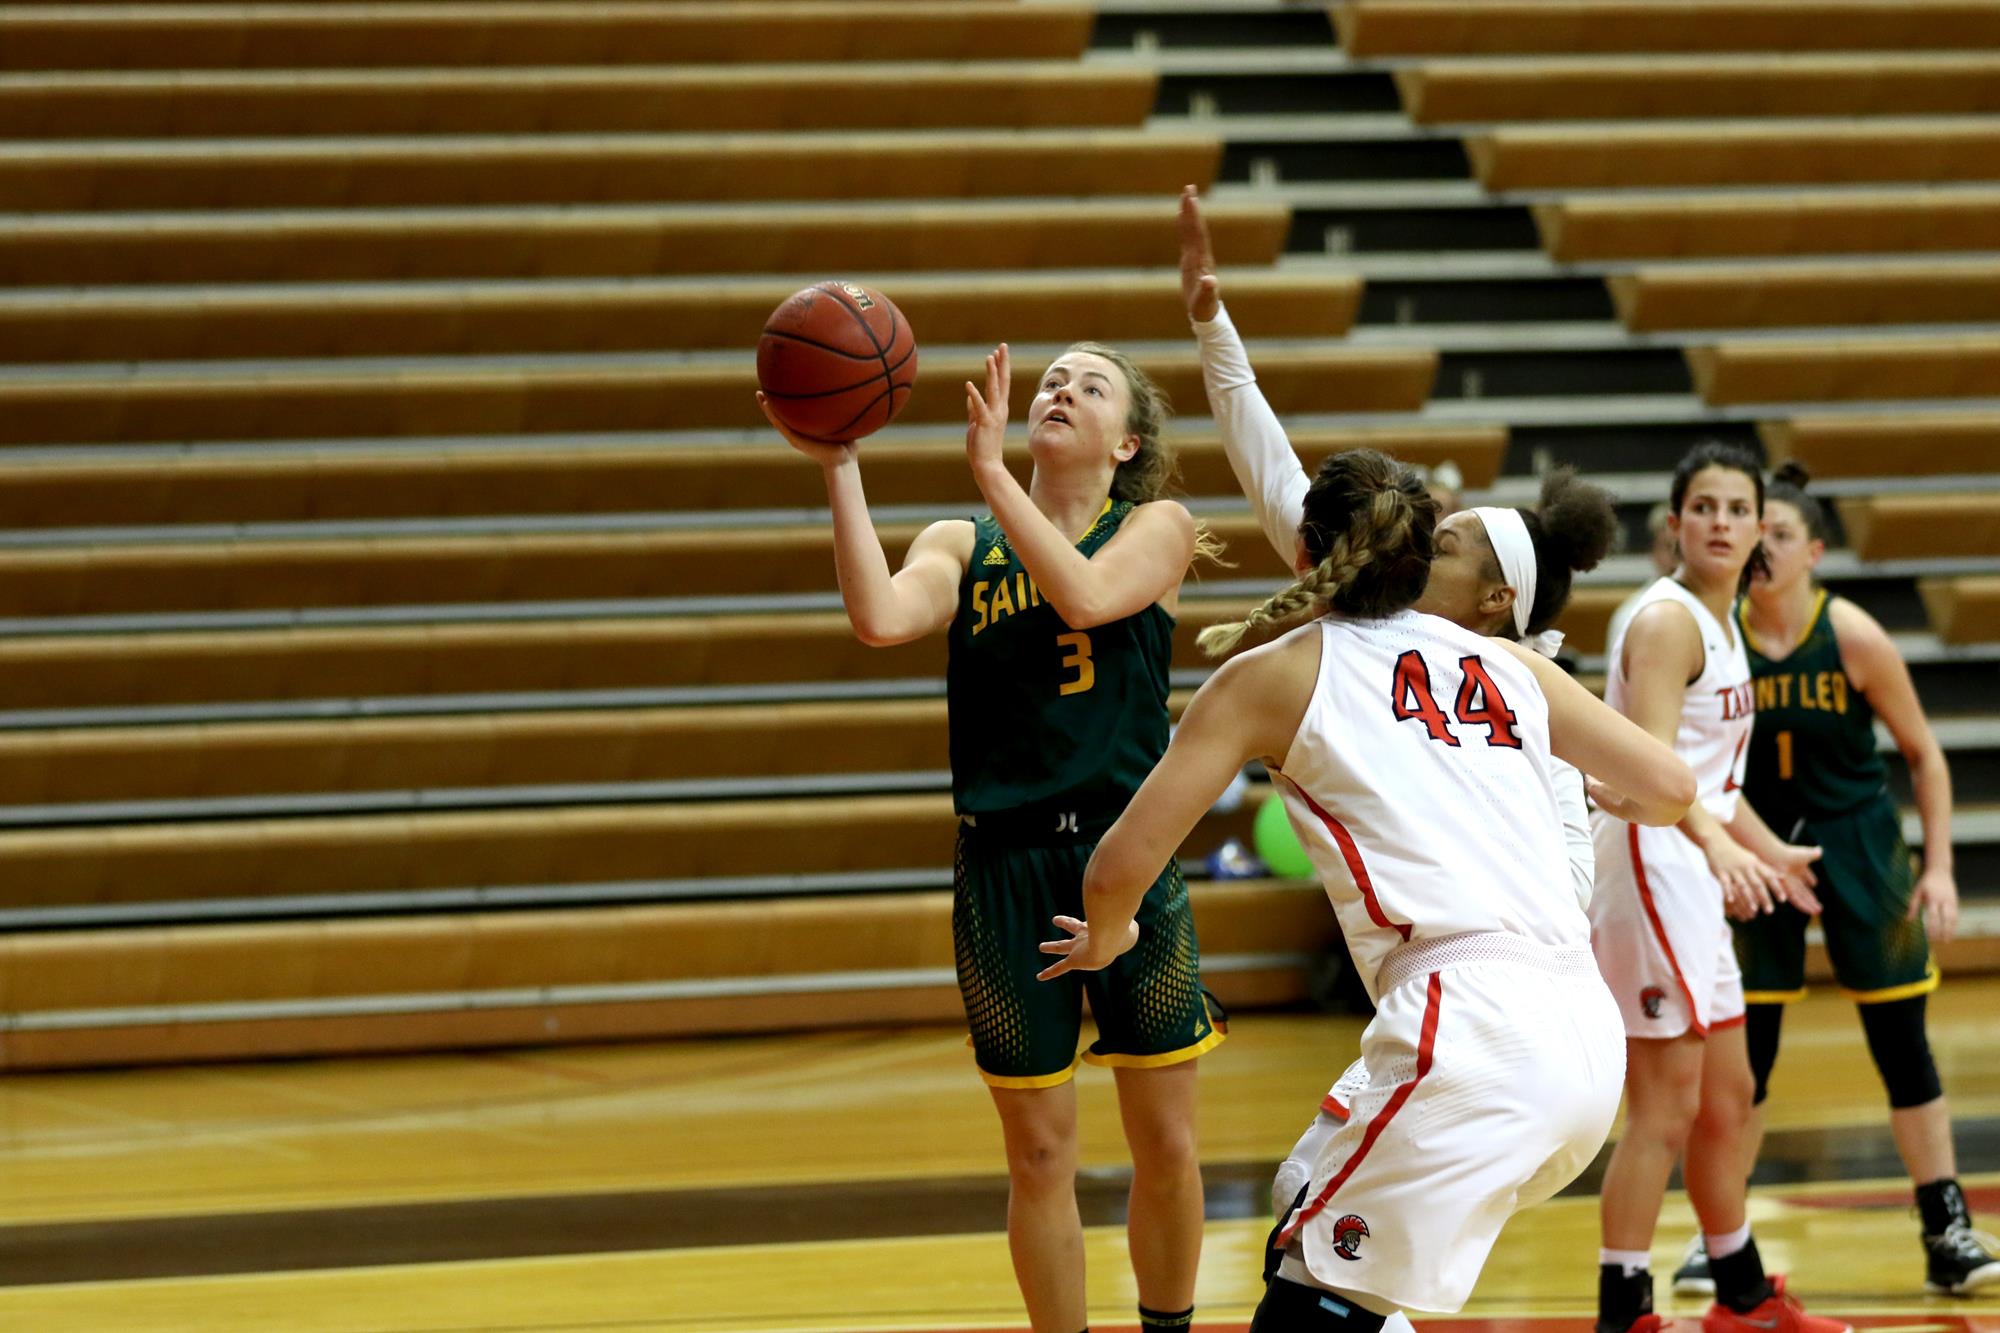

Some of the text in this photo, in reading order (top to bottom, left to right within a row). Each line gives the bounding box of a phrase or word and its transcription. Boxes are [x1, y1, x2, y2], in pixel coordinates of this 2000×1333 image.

[982, 558, 1009, 566] adidas
[972, 572, 1041, 636] SAI
[1056, 632, 1095, 696] 3
[1391, 649, 1523, 750] 44
[1777, 730, 1793, 780] 1
